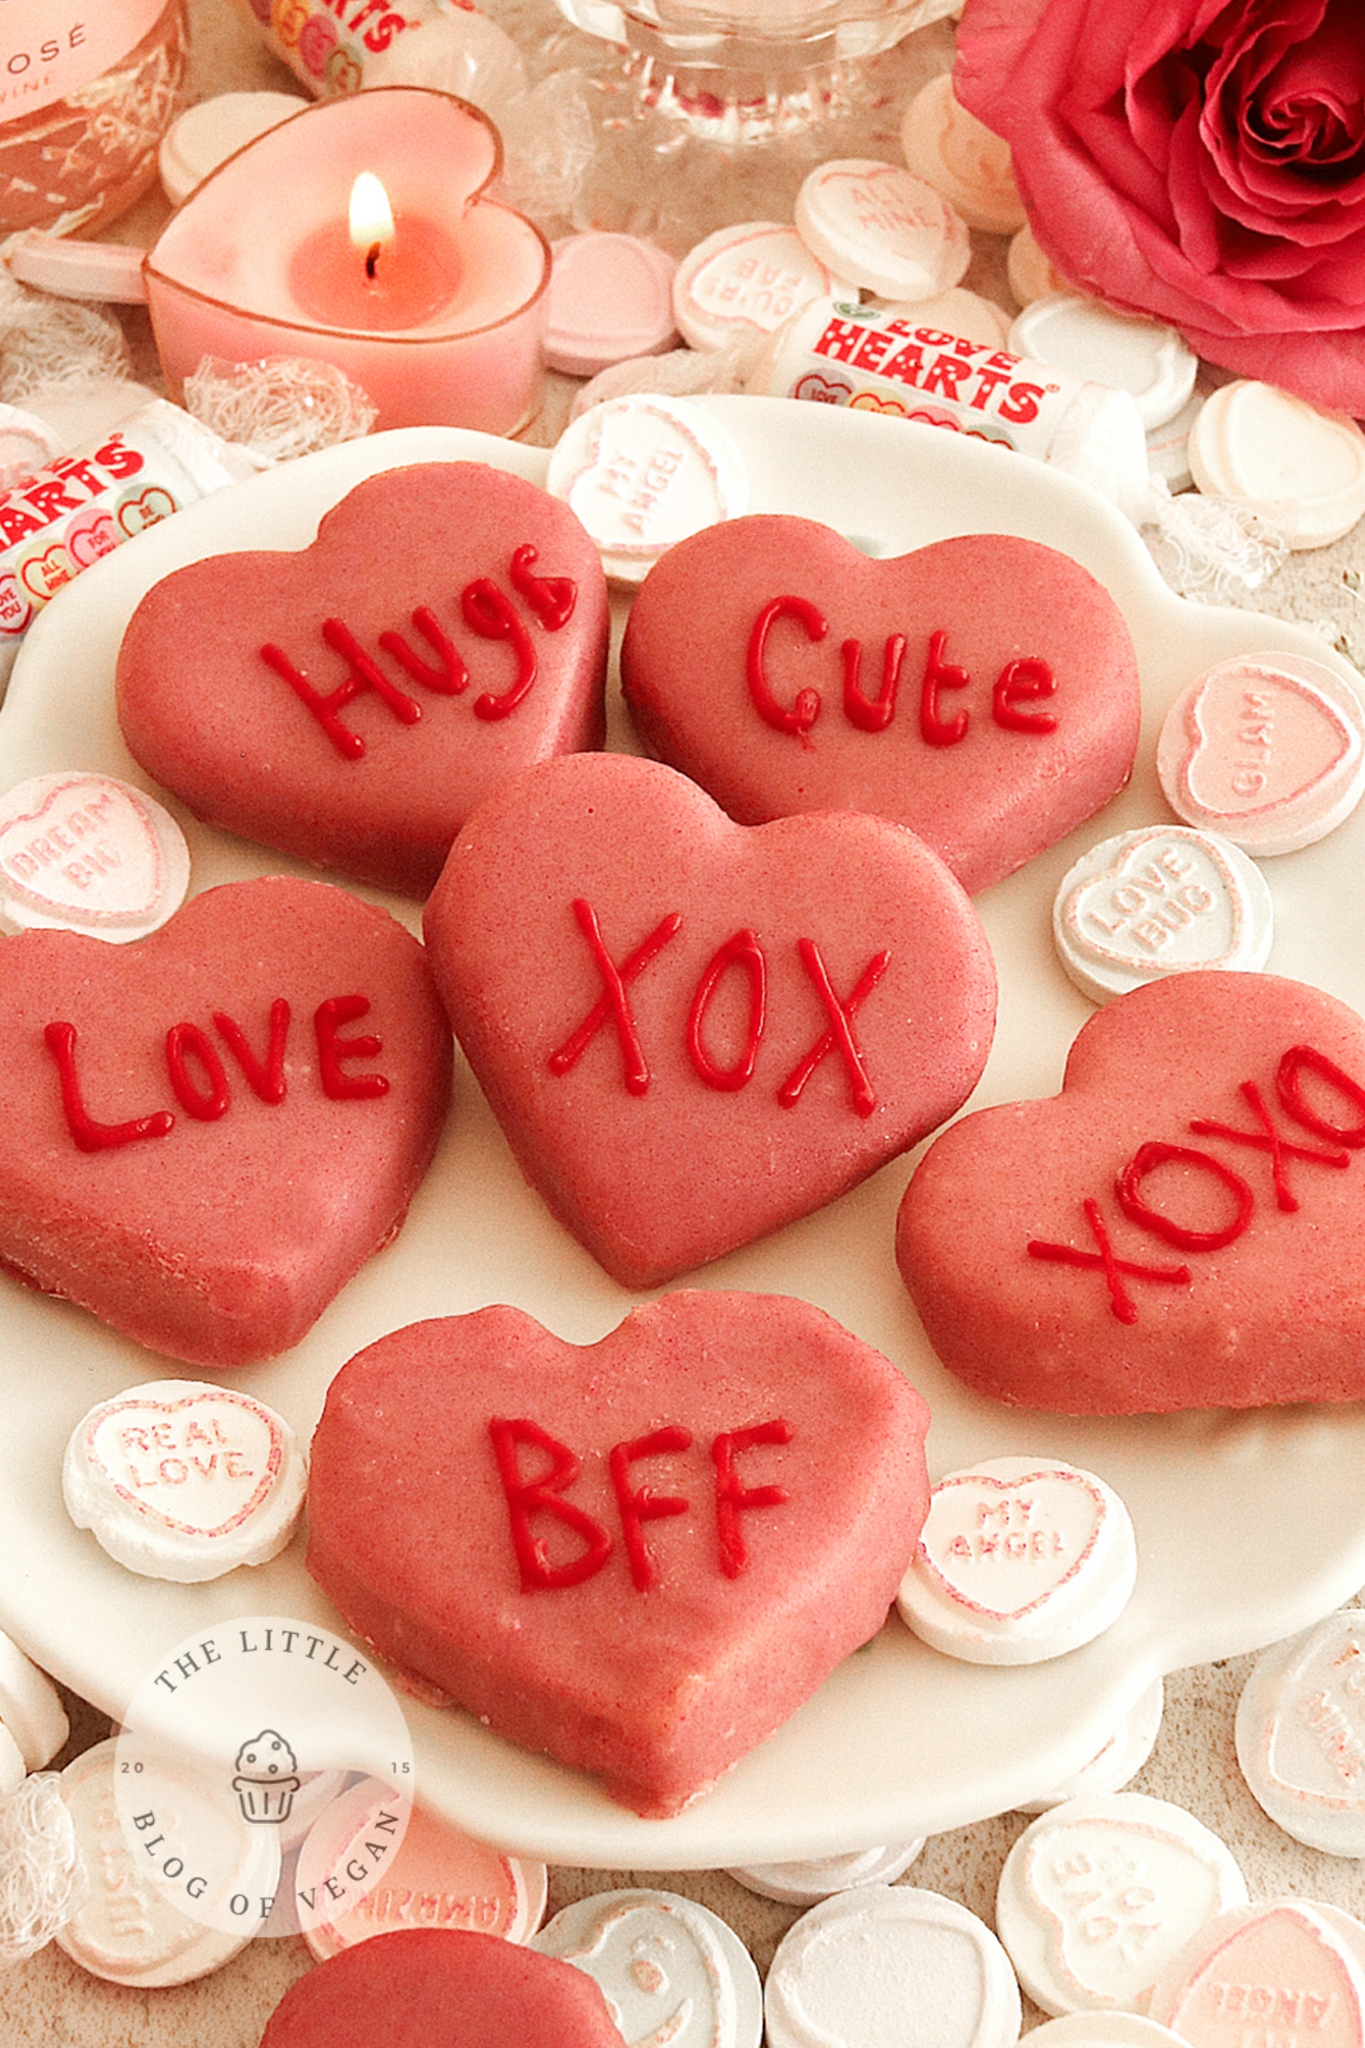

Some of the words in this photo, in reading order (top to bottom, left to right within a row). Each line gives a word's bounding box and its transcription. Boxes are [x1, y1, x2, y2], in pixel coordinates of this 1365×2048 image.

[7, 22, 86, 74] OSÉ
[701, 278, 794, 316] OU'RE
[812, 317, 1046, 424] HEARTS
[885, 318, 1024, 371] LOVE
[0, 442, 144, 553] ARTS
[620, 450, 684, 537] ANGEL
[41, 559, 61, 577] ALL
[259, 543, 578, 759] Hugs
[745, 595, 1060, 752] Cute
[1231, 689, 1275, 799] GLAM
[11, 792, 111, 880] DREAM
[1087, 850, 1198, 936] LOVE
[1133, 882, 1214, 950] BUG
[547, 898, 892, 1118] XOX
[43, 994, 391, 1154] LOVE
[1026, 1044, 1365, 1325] XOXO
[120, 1418, 229, 1452] REAL
[128, 1451, 254, 1489] LOVE
[487, 1416, 794, 1596] BFF
[943, 1530, 1063, 1562] ANGEL
[977, 1499, 1034, 1528] MY
